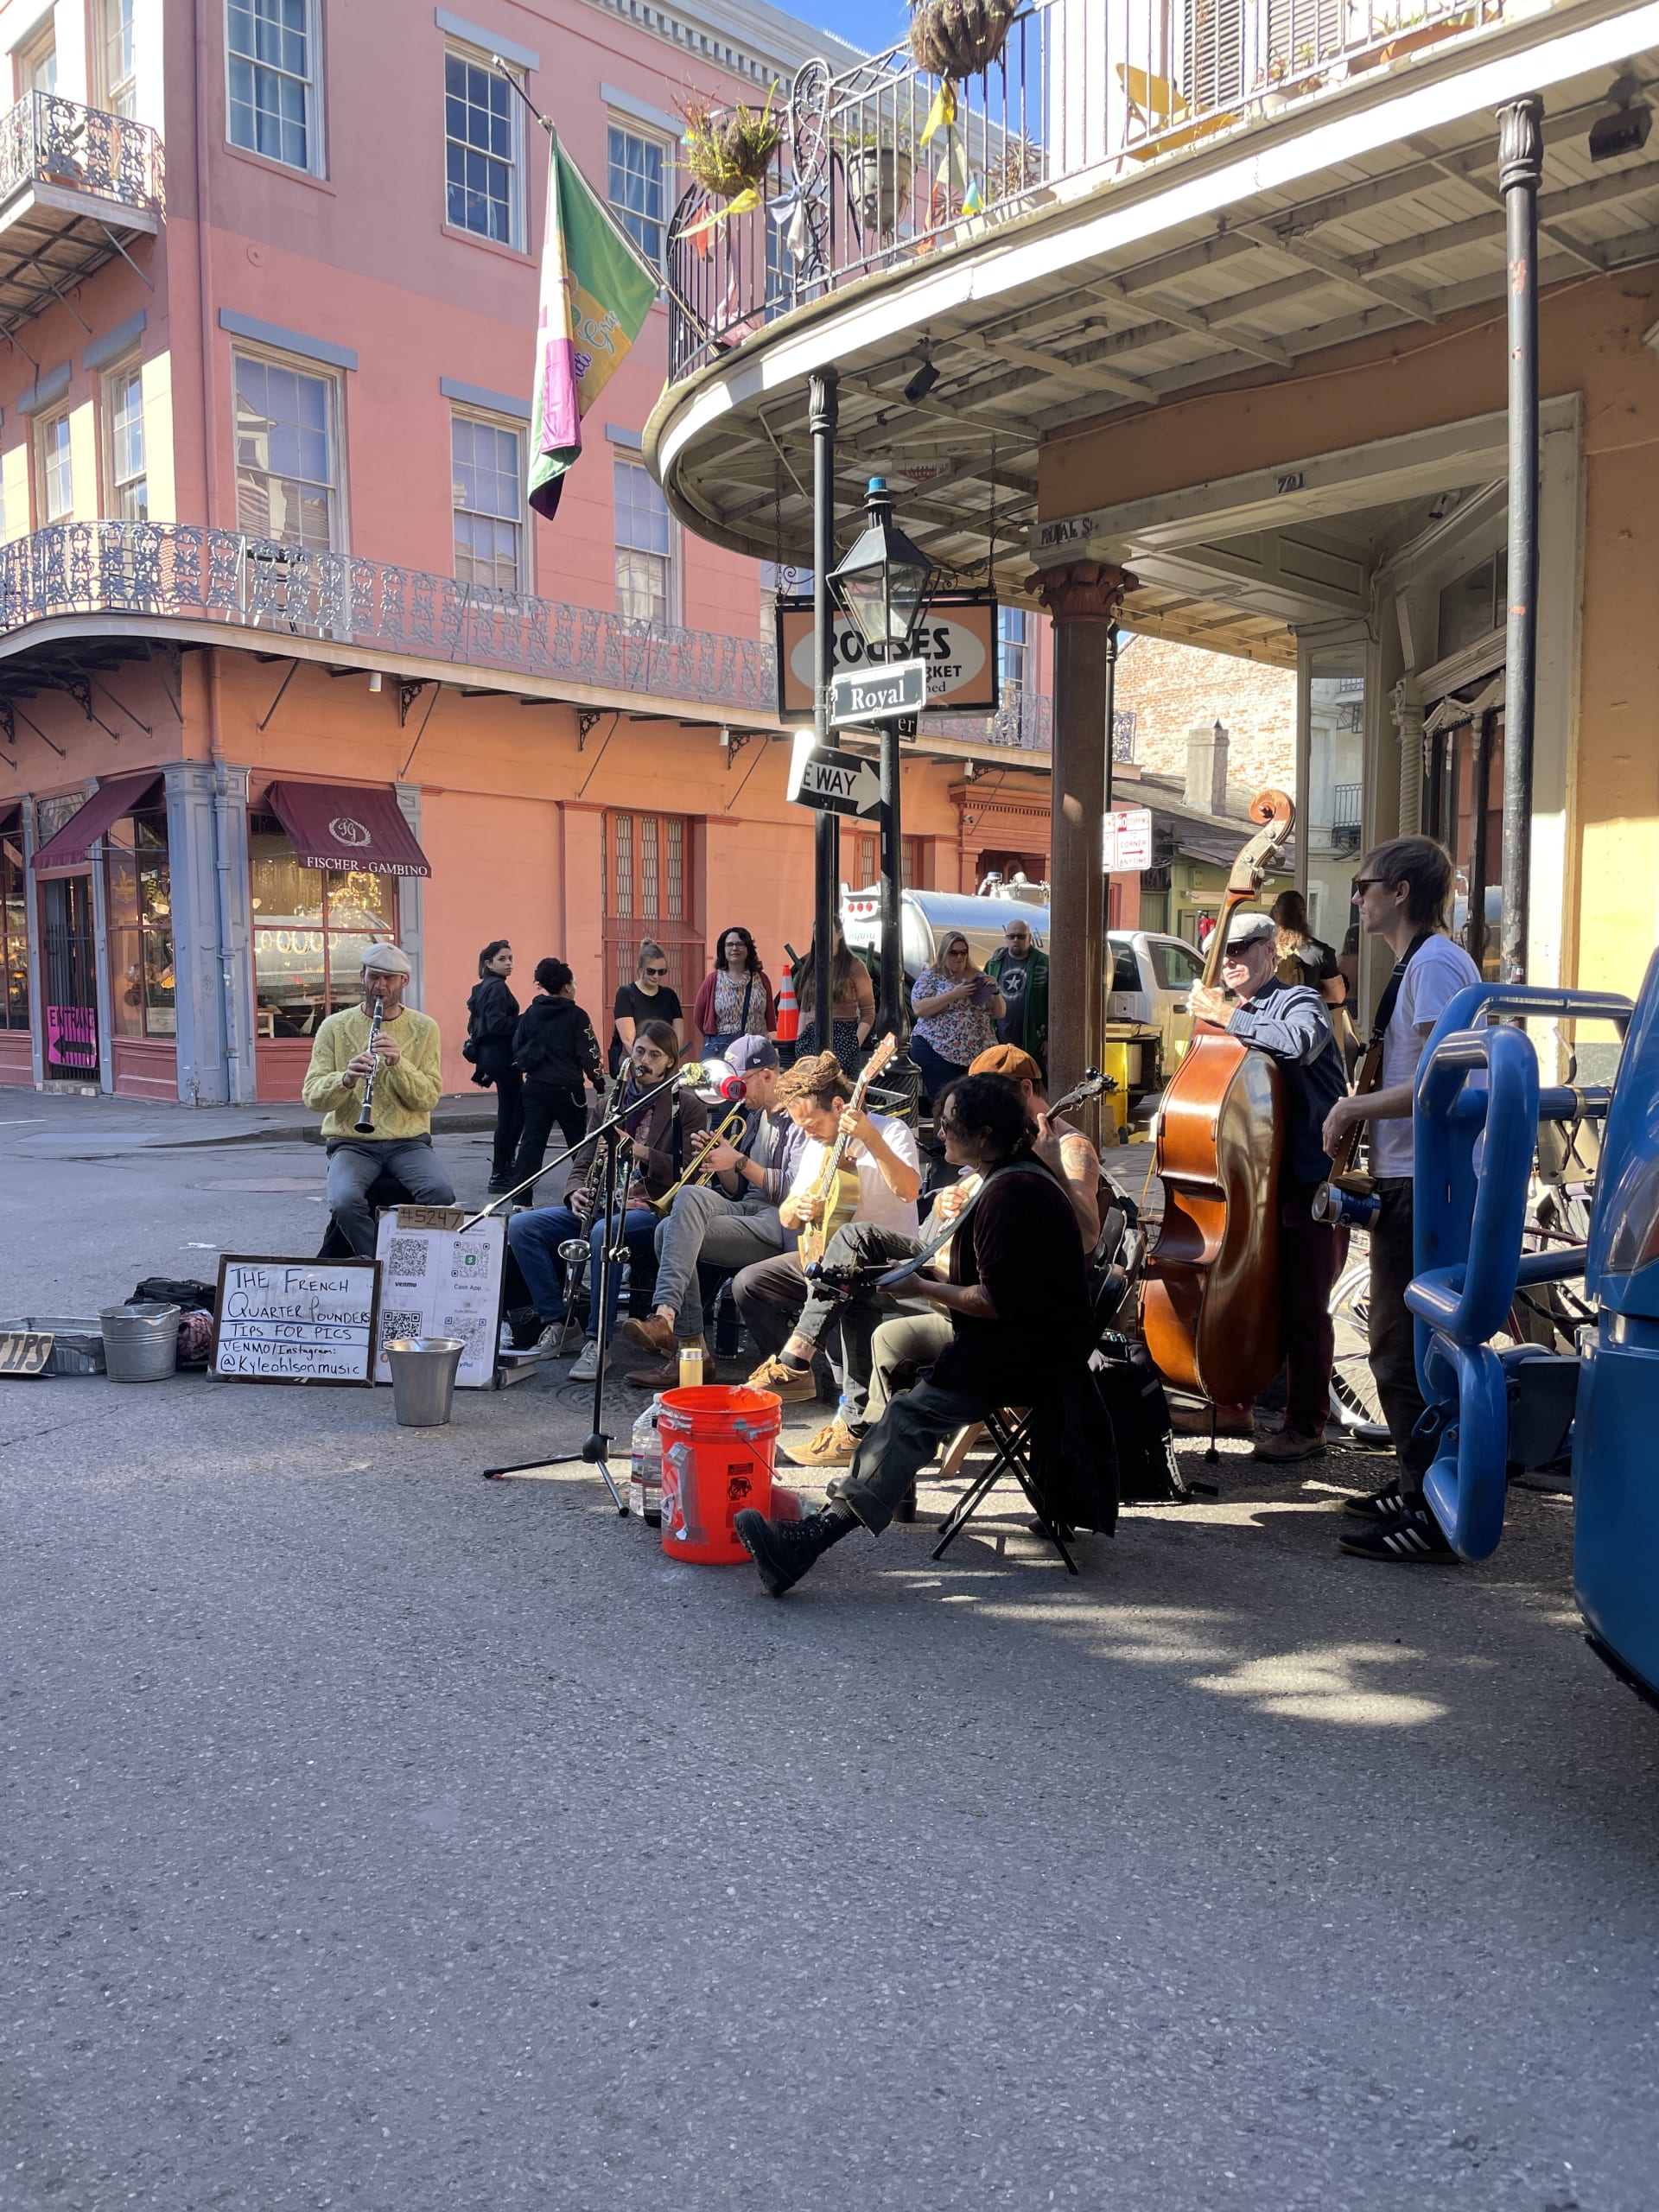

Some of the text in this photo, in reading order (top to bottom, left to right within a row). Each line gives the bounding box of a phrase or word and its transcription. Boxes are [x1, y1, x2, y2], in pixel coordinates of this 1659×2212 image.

[925, 665, 962, 678] RKET
[851, 679, 905, 710] Royal
[817, 766, 857, 796] WAY
[1120, 840, 1146, 849] CORNER
[307, 856, 359, 871] FISCHER
[368, 861, 428, 876] GAMBINO
[1120, 856, 1147, 865] ANYTIME
[400, 1210, 461, 1228] #5247
[230, 1267, 348, 1293] THE FRENCH
[228, 1292, 370, 1325] QUARTER POUNDERS
[230, 1323, 352, 1339] TIPS FOR PICS
[0, 1333, 51, 1371] IPS
